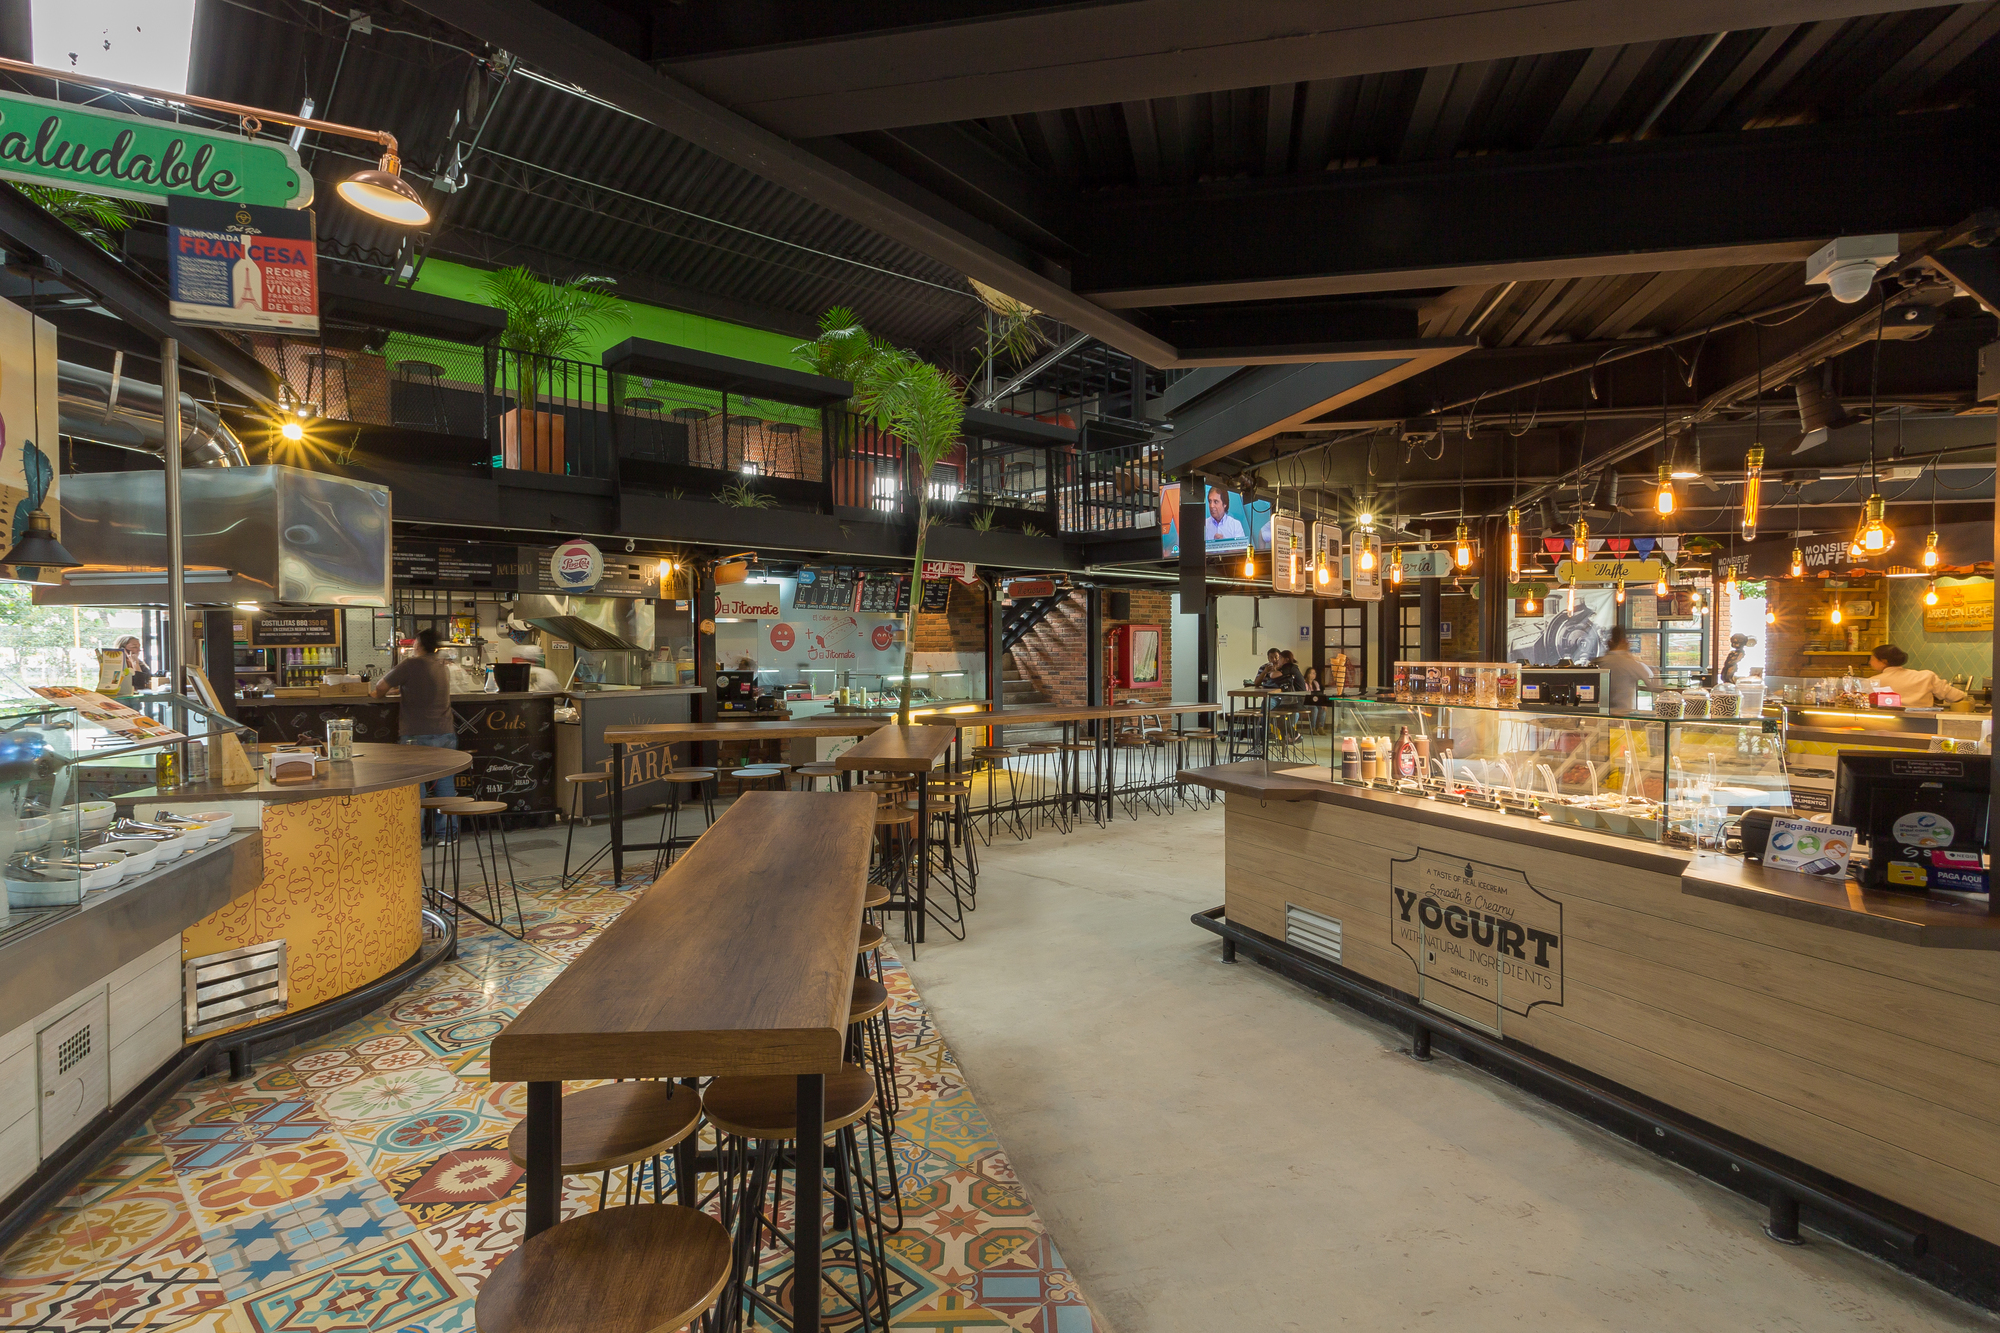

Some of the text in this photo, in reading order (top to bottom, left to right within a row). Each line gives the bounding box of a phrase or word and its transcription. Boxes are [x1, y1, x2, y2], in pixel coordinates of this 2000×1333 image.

[0, 112, 242, 197] aludable
[178, 227, 240, 242] TEMPORADA
[178, 235, 309, 266] FRANCESA
[265, 266, 311, 279] RECIBE
[266, 284, 312, 297] VINOS
[268, 302, 290, 312] DEL
[1805, 542, 1850, 555] MONSIE
[1718, 554, 1750, 566] MONSIEUR
[1594, 563, 1629, 578] Waffle
[732, 601, 779, 615] Jitomate
[1950, 608, 1964, 616] CON
[1966, 606, 1991, 616] LECHE
[825, 650, 856, 659] Jitomate
[486, 710, 526, 730] Cuts
[486, 784, 502, 793] HAM
[1774, 820, 1803, 830] ¡Paga
[1805, 825, 1828, 834] aquí
[1433, 870, 1452, 882] TASTE
[1462, 877, 1477, 887] REAL
[1478, 882, 1508, 895] ICECREAM
[1938, 872, 1960, 880] PAGA
[1425, 884, 1515, 921] Smooth & Creamy
[1394, 887, 1558, 968] YOGURT
[1400, 927, 1552, 990] WITH NATURAL INGREDIENTS
[1450, 967, 1489, 987] SINCE 2015
